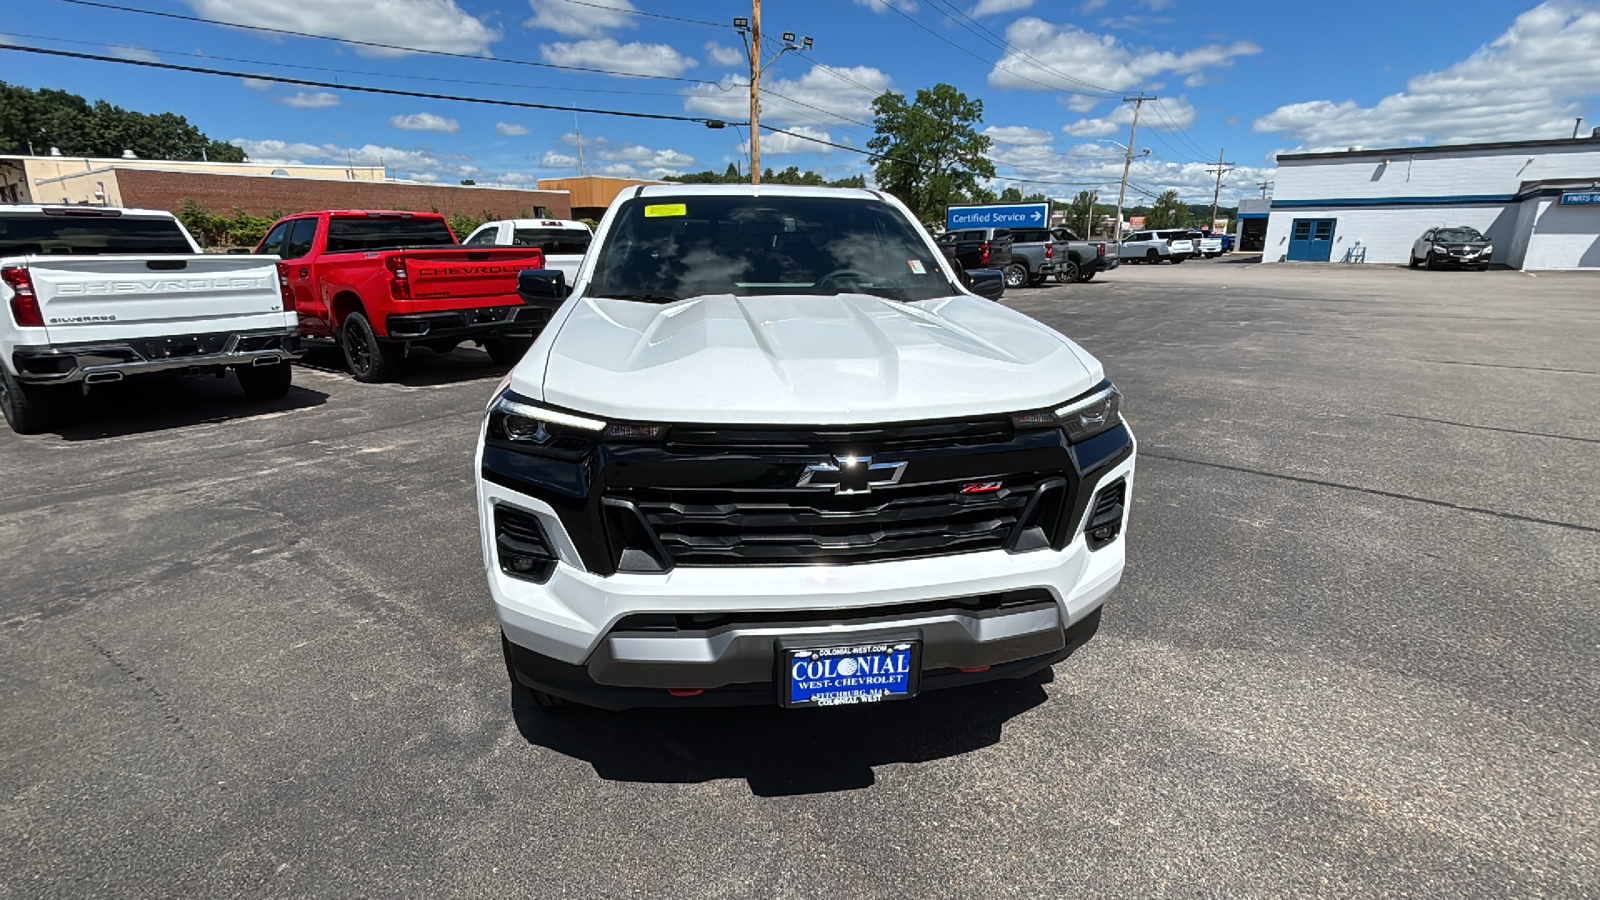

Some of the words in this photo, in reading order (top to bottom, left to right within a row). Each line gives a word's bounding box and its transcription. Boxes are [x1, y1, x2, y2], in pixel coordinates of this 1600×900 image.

[952, 212, 990, 223] Certified
[993, 212, 1026, 222] Service
[56, 278, 267, 295] CHEVROLET
[49, 315, 117, 324] SILVERADO
[819, 645, 888, 657] COLONIAL-WEST.COM
[791, 654, 910, 681] COLONIAL
[818, 695, 859, 706] COLONIAL
[861, 694, 882, 703] WEST
